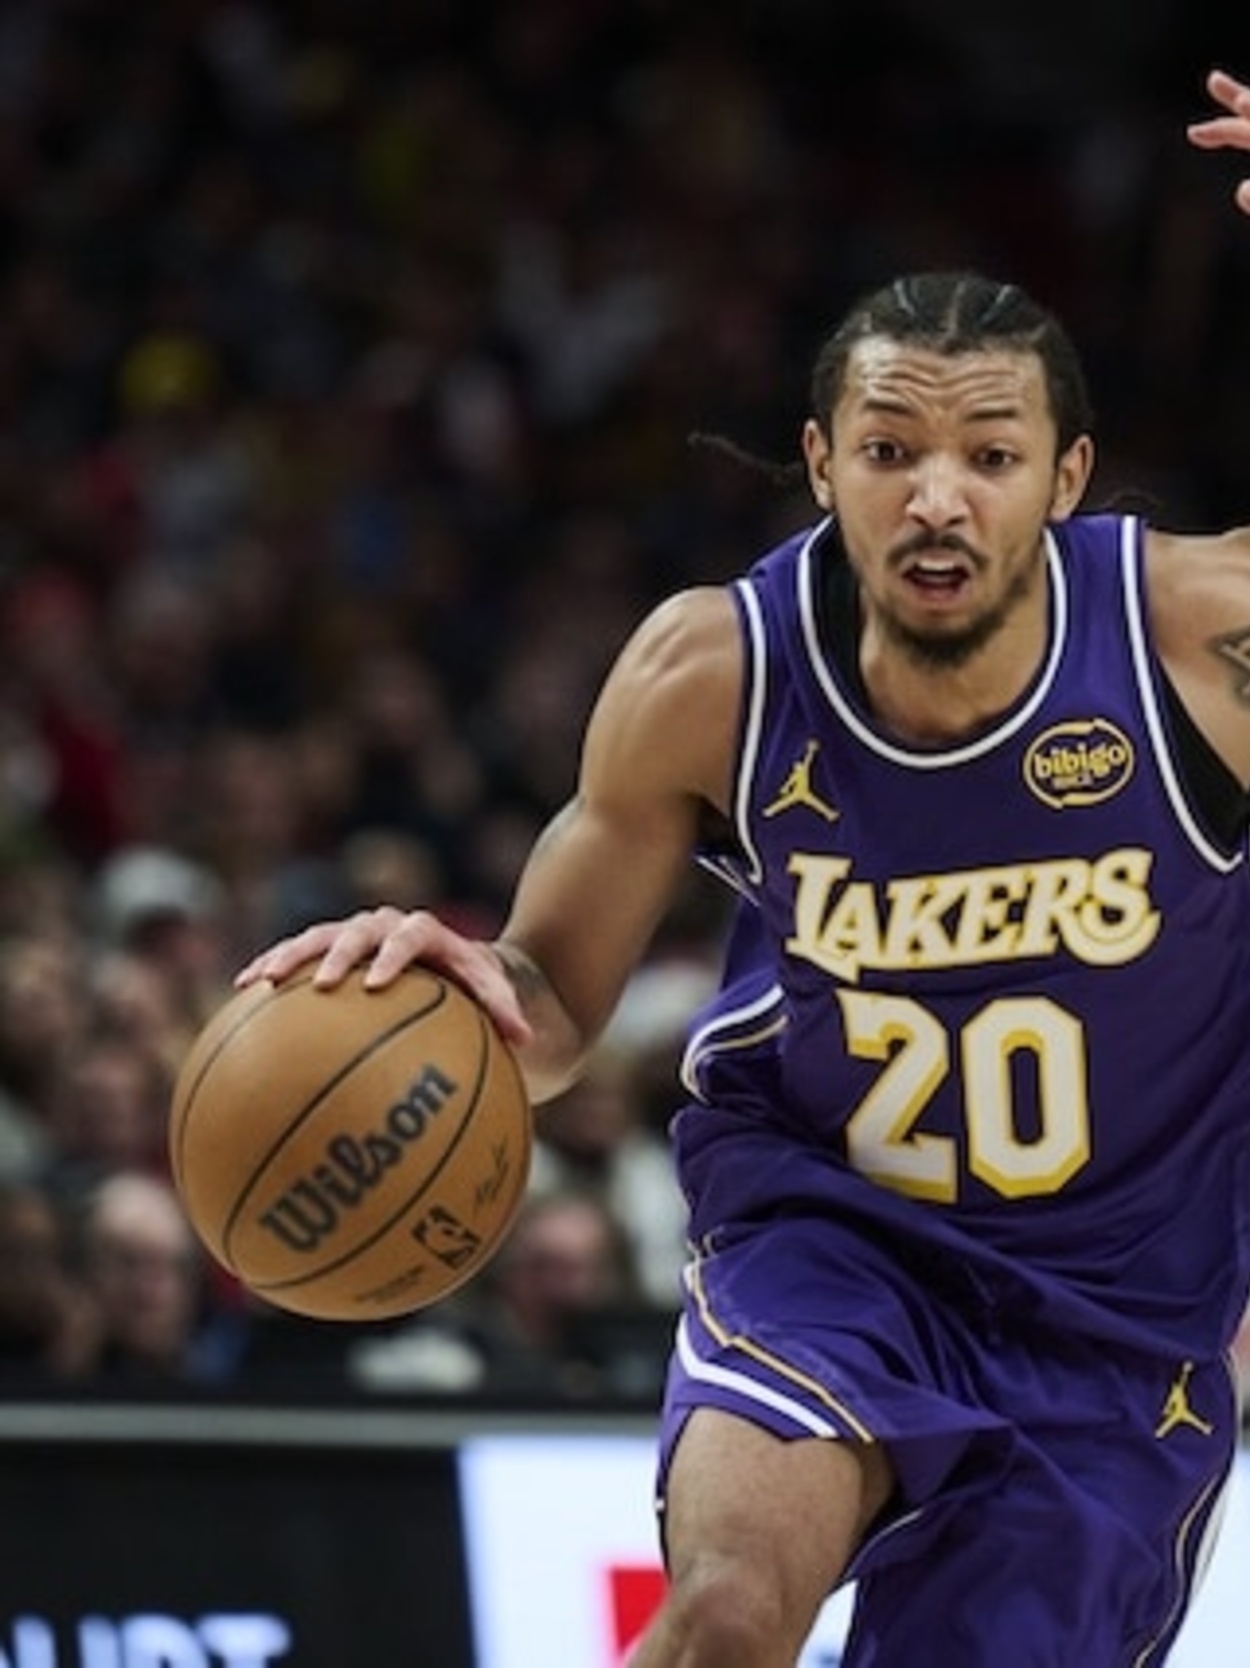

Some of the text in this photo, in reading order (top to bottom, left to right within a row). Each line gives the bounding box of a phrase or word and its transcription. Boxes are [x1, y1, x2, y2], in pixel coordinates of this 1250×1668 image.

[1035, 743, 1126, 778] bibigo
[784, 848, 1162, 984] LAKERS
[259, 1065, 458, 1252] Wilson
[836, 987, 1092, 1204] 20
